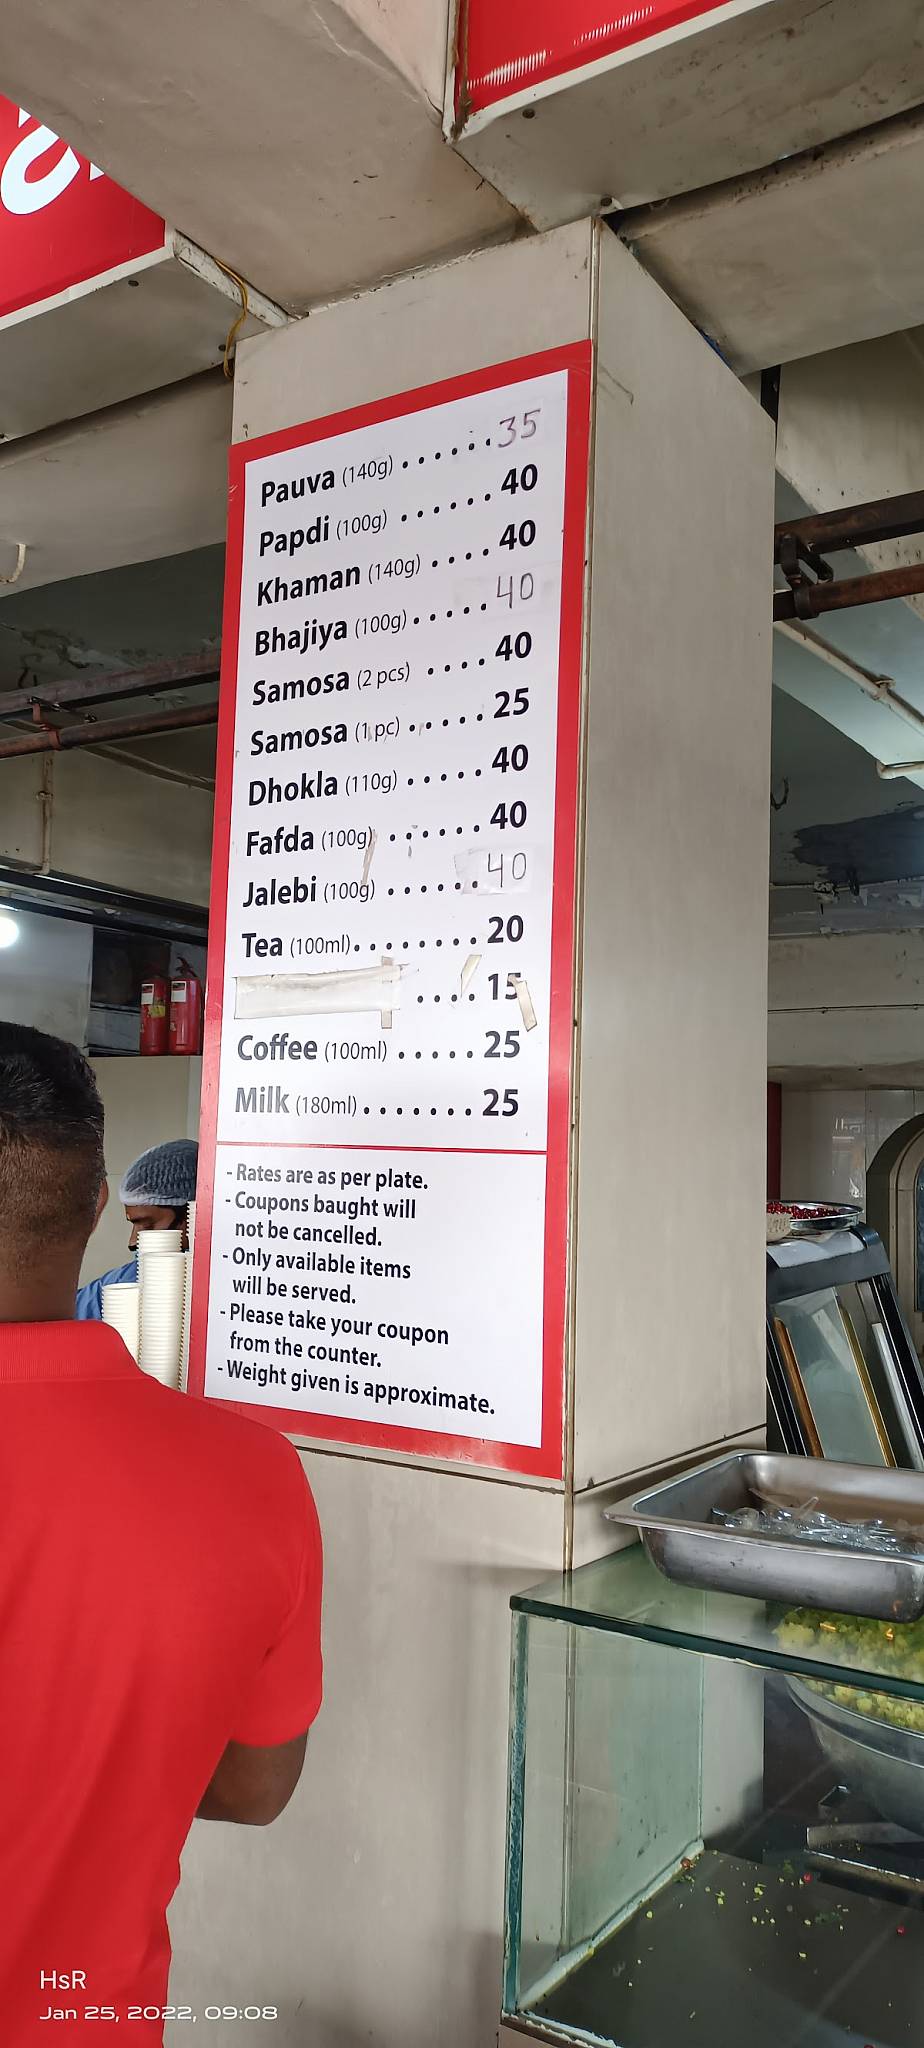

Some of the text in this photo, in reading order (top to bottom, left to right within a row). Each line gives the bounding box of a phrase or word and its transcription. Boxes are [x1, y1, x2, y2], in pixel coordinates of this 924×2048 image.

[498, 408, 541, 448] 35
[261, 455, 393, 507] Pauva (140g)
[259, 464, 538, 556] Papdi (100g) 40
[257, 519, 536, 606] Khaman (140g) 40
[496, 572, 534, 609] 40
[255, 609, 407, 656] Bhajiya (100g)
[252, 631, 532, 706] Samosa (2 pcs) 40
[250, 688, 530, 756] Samosa (1 pc) 25
[248, 744, 528, 806] Dhokla (110g) 40
[246, 801, 527, 856] Fafda (100g) 40
[487, 852, 527, 888] 40
[242, 876, 375, 908] Jalebi (100g)
[242, 915, 524, 958] Tea (100ml) 20
[237, 1030, 521, 1063] Coffee (100ml) 25
[235, 1086, 519, 1118] Milk (180ml) 25
[285, 1168, 313, 1184] are
[317, 1168, 336, 1185] as
[340, 1170, 371, 1190] per
[375, 1169, 428, 1192] plate.
[313, 1195, 378, 1219] baught
[383, 1198, 416, 1219] will
[235, 1221, 382, 1247] not be cancelled.
[275, 1251, 356, 1274] available
[360, 1257, 411, 1280] items
[232, 1276, 356, 1304] will be served.
[288, 1309, 326, 1331] take
[331, 1317, 373, 1336] your
[377, 1321, 449, 1346] coupon
[230, 1331, 382, 1368] from the counter.
[291, 1369, 340, 1393] given
[345, 1375, 359, 1395] is
[363, 1382, 496, 1415] approximate.
